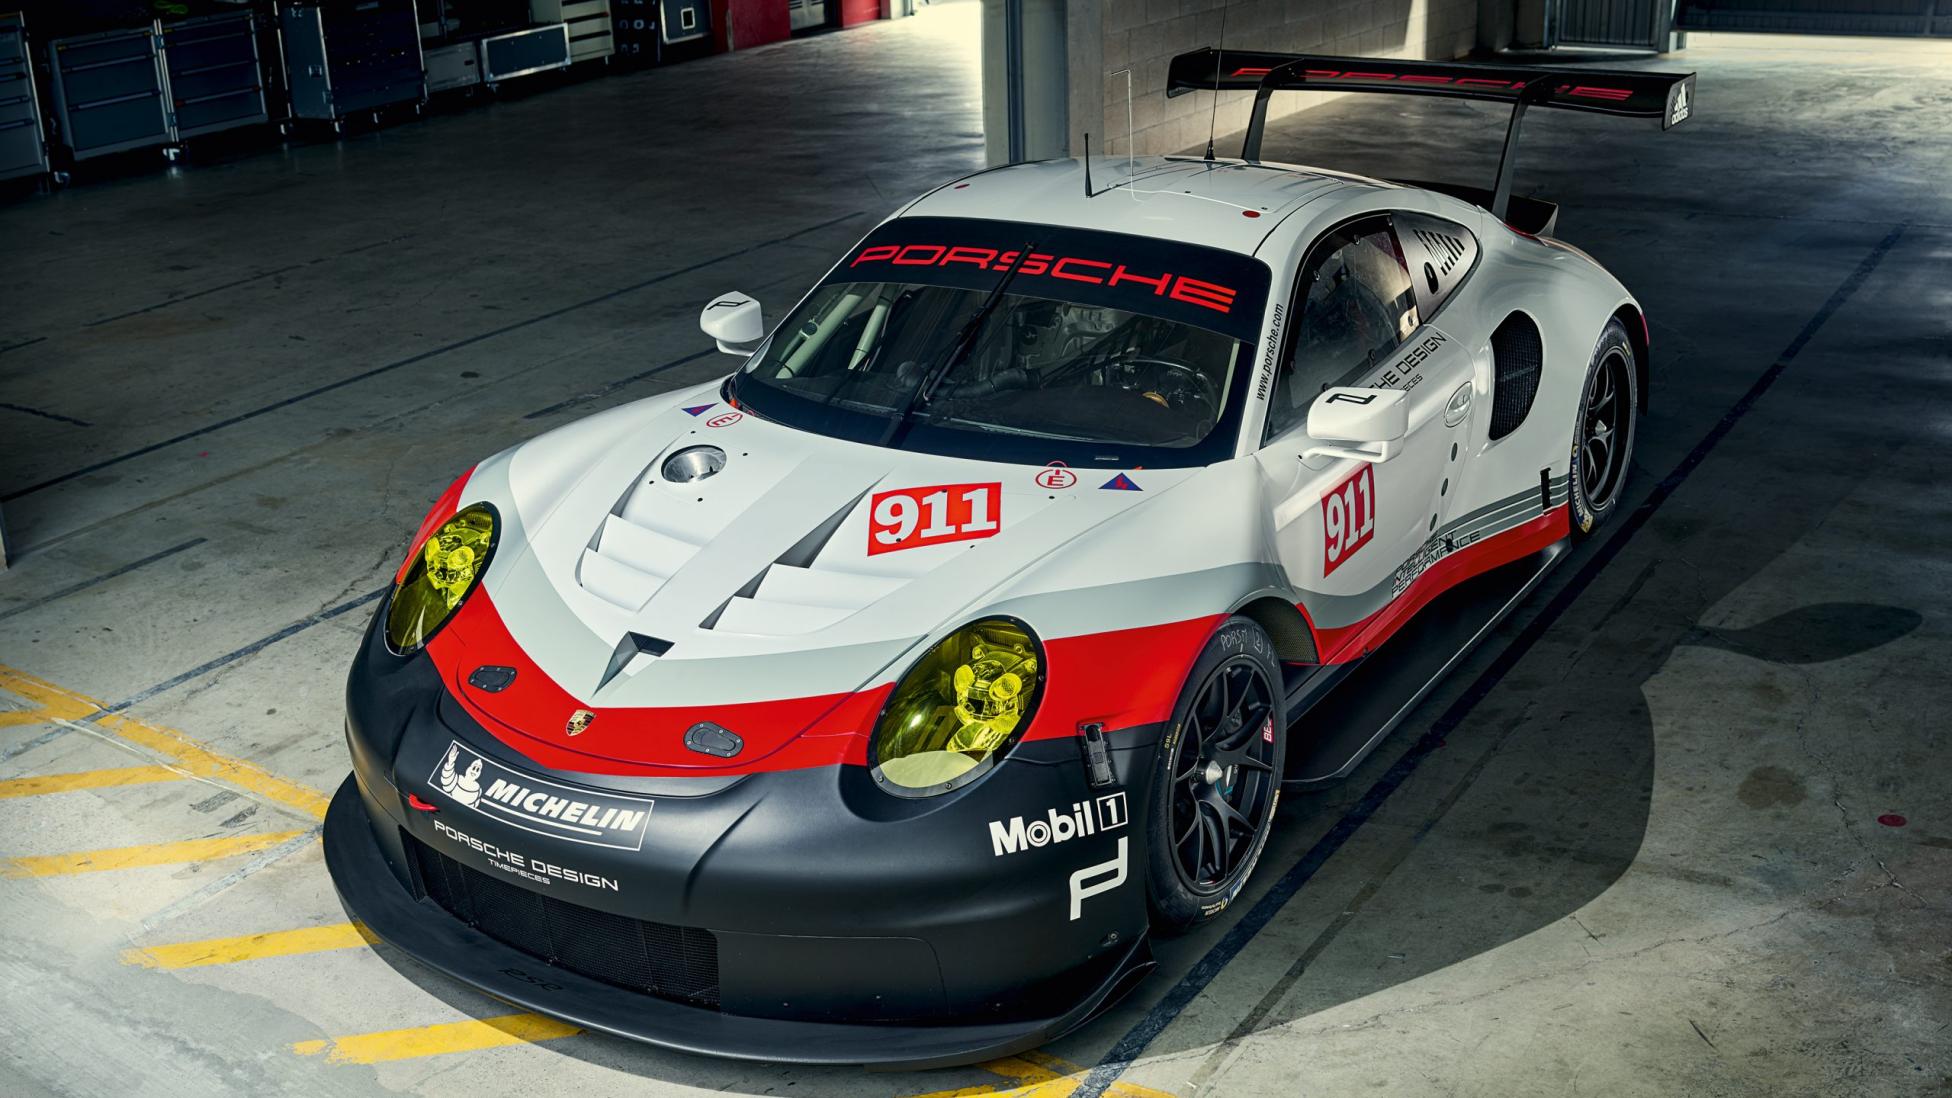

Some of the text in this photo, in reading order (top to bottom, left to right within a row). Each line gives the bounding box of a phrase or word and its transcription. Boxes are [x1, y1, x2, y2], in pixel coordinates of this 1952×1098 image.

[850, 244, 1237, 313] PORSCHE
[1256, 303, 1284, 401] www.porsche.com
[1395, 332, 1447, 375] DESIGN
[874, 487, 998, 545] 911
[1326, 468, 1374, 563] 911
[1572, 464, 1584, 517] MICHELIN
[485, 778, 645, 831] MICHELIN
[988, 800, 1095, 856] Mobil
[434, 819, 619, 892] PORSCHE DESIGN
[487, 857, 551, 885] TIMEPIECES
